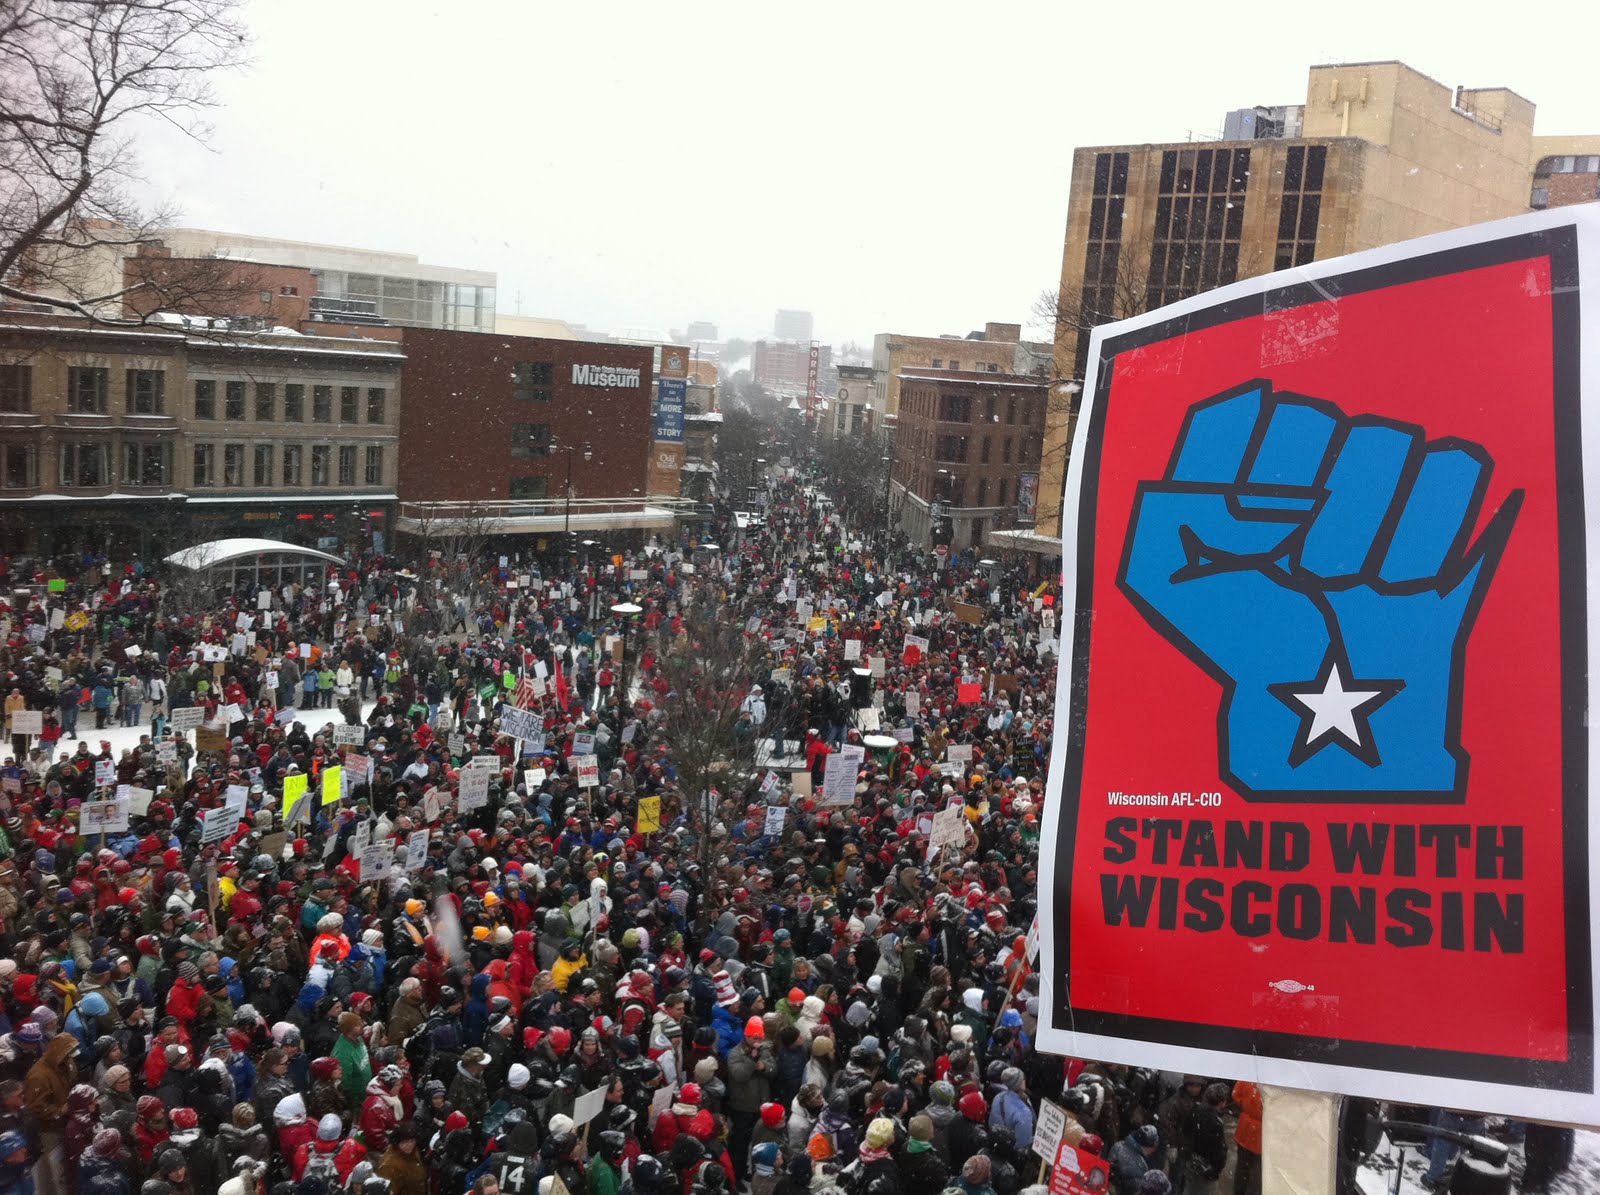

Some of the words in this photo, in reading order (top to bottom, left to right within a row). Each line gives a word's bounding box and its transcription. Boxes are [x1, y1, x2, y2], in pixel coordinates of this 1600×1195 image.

[572, 364, 640, 388] Museum
[807, 350, 818, 417] ORPHEUM
[660, 403, 683, 413] MORE
[657, 427, 682, 437] STORY
[338, 725, 361, 733] CLOSED
[500, 720, 540, 743] WISCONSIN
[502, 709, 518, 723] WE
[524, 714, 543, 731] ARE
[1107, 792, 1168, 806] Wisconsin
[1171, 792, 1222, 806] AFL-CIO
[1103, 816, 1310, 872] STAND
[1326, 822, 1524, 880] WITH
[1100, 873, 1525, 954] WISCONSIN
[499, 1165, 526, 1192] 14
